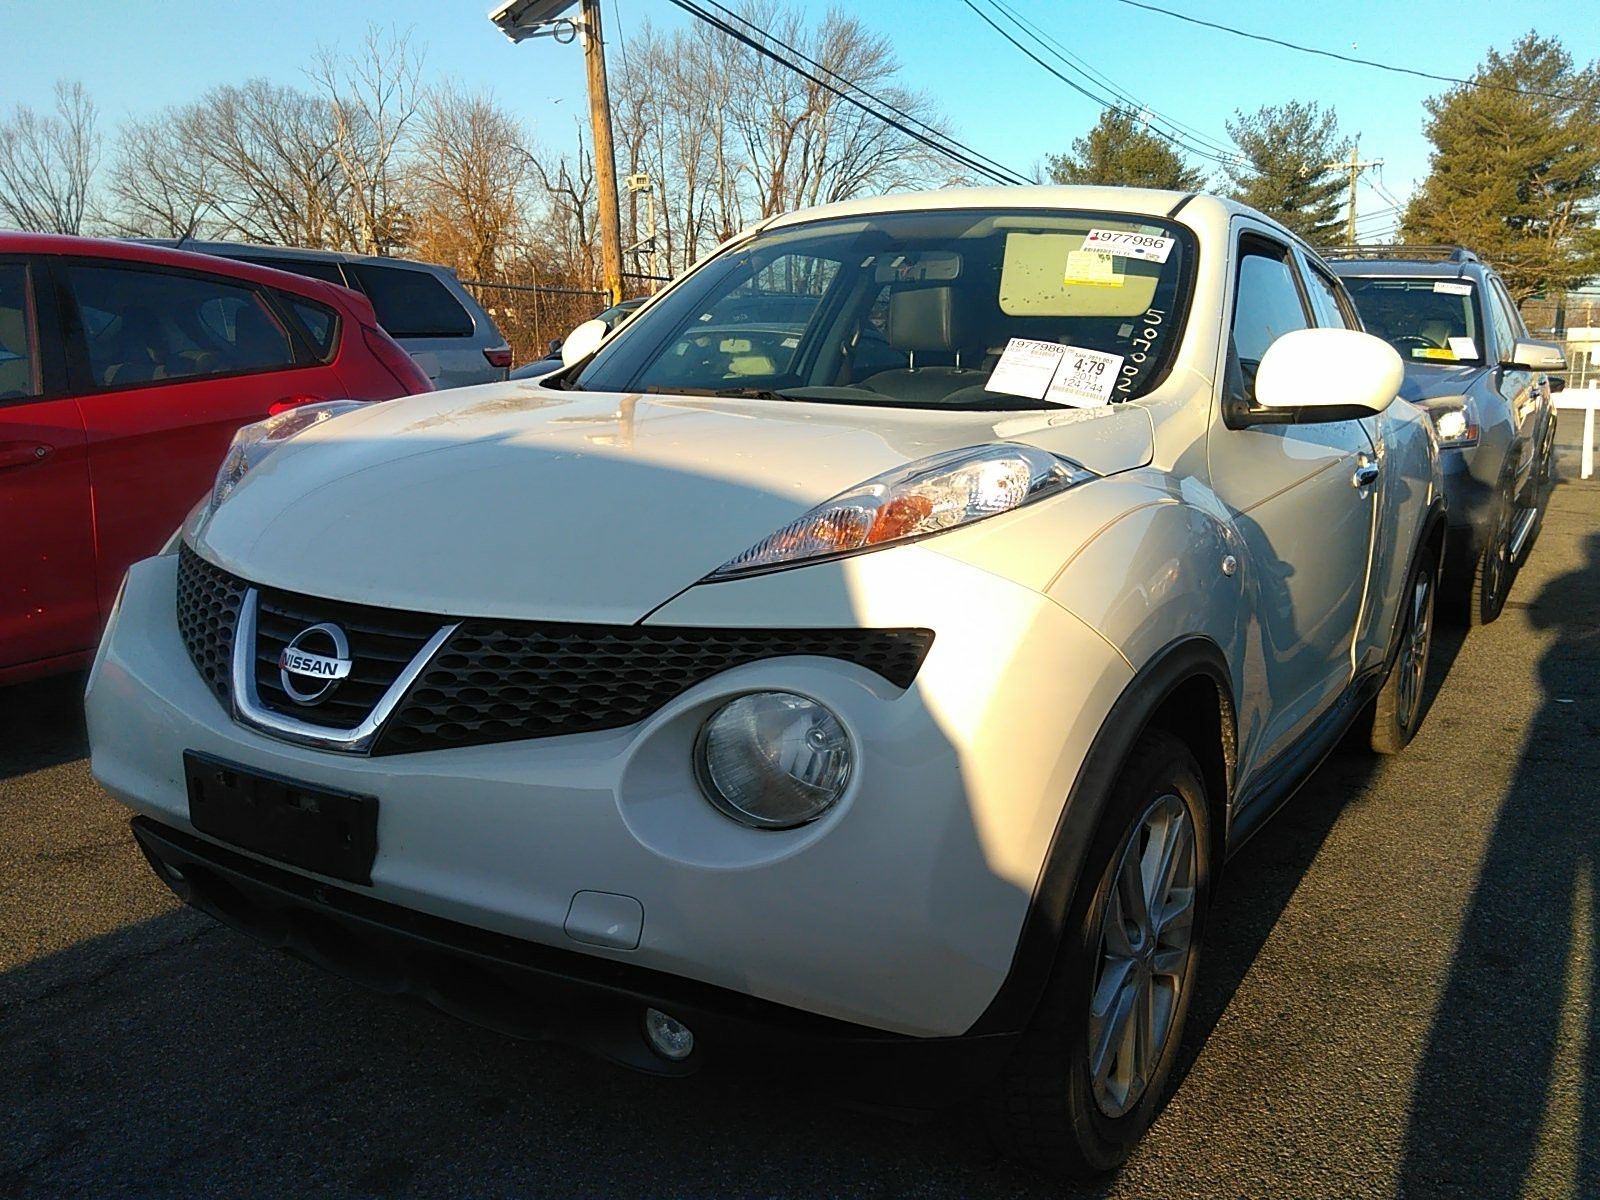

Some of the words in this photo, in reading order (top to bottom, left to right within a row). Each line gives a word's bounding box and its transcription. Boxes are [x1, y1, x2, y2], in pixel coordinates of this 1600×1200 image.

[1092, 231, 1165, 249] 1977986
[1010, 340, 1065, 354] 1977986
[1073, 358, 1106, 376] 4:79
[1073, 371, 1099, 382] 2011
[283, 653, 338, 676] NISSAN
